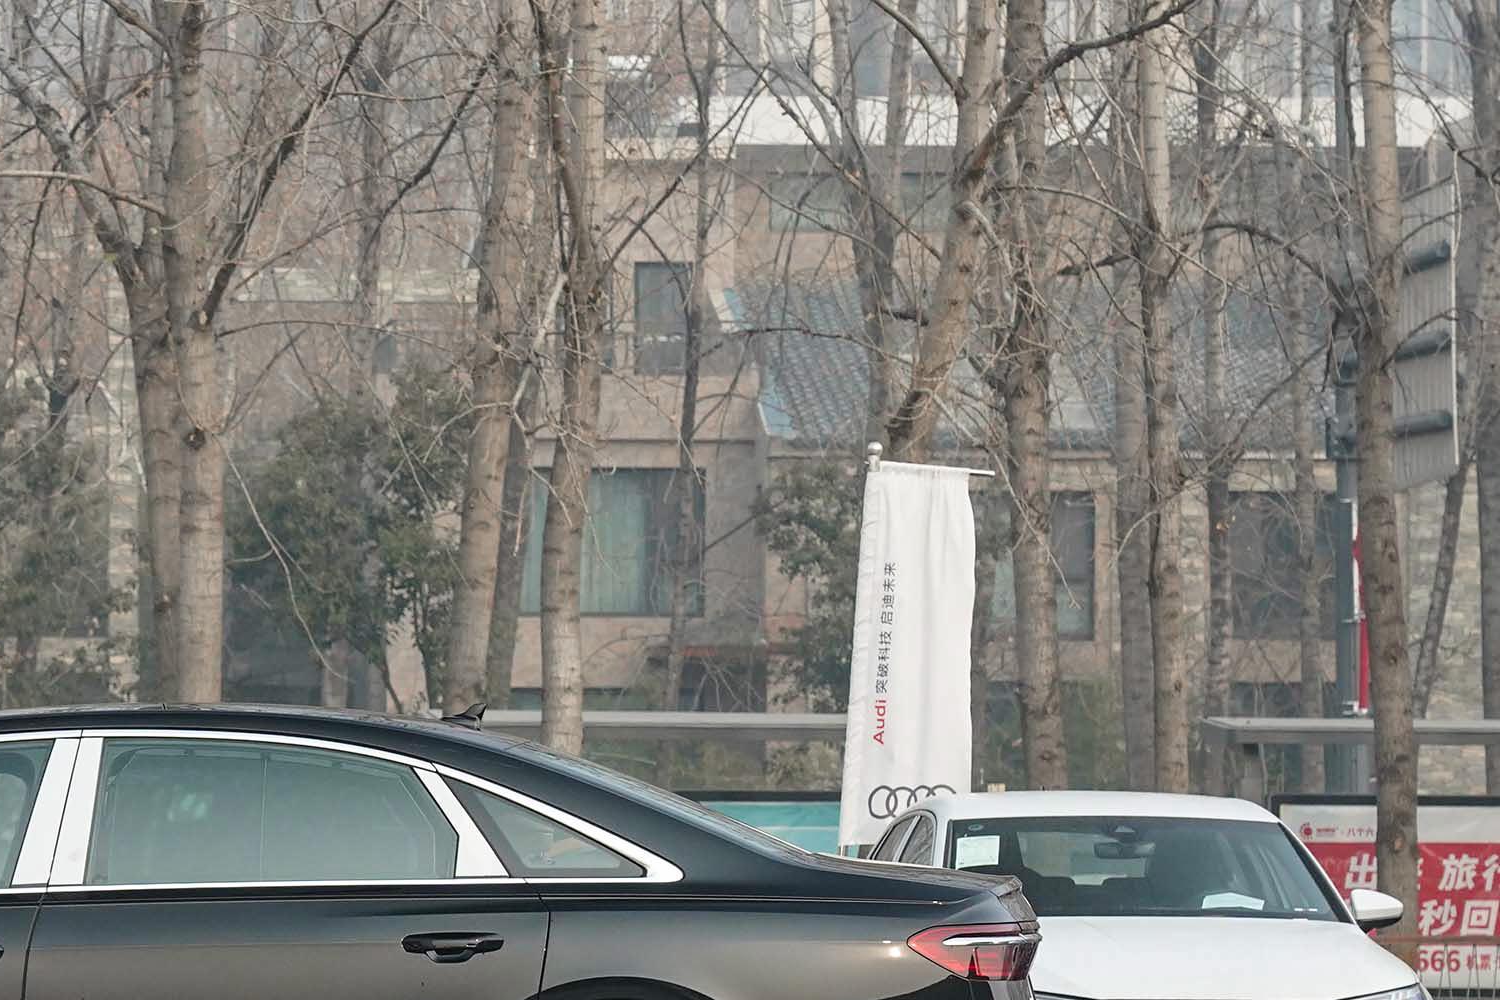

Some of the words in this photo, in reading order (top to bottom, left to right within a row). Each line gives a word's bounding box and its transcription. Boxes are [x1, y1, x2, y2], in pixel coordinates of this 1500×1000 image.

[880, 562, 897, 626] 启迪未来
[876, 630, 892, 694] 突破科技
[873, 700, 887, 745] Audi
